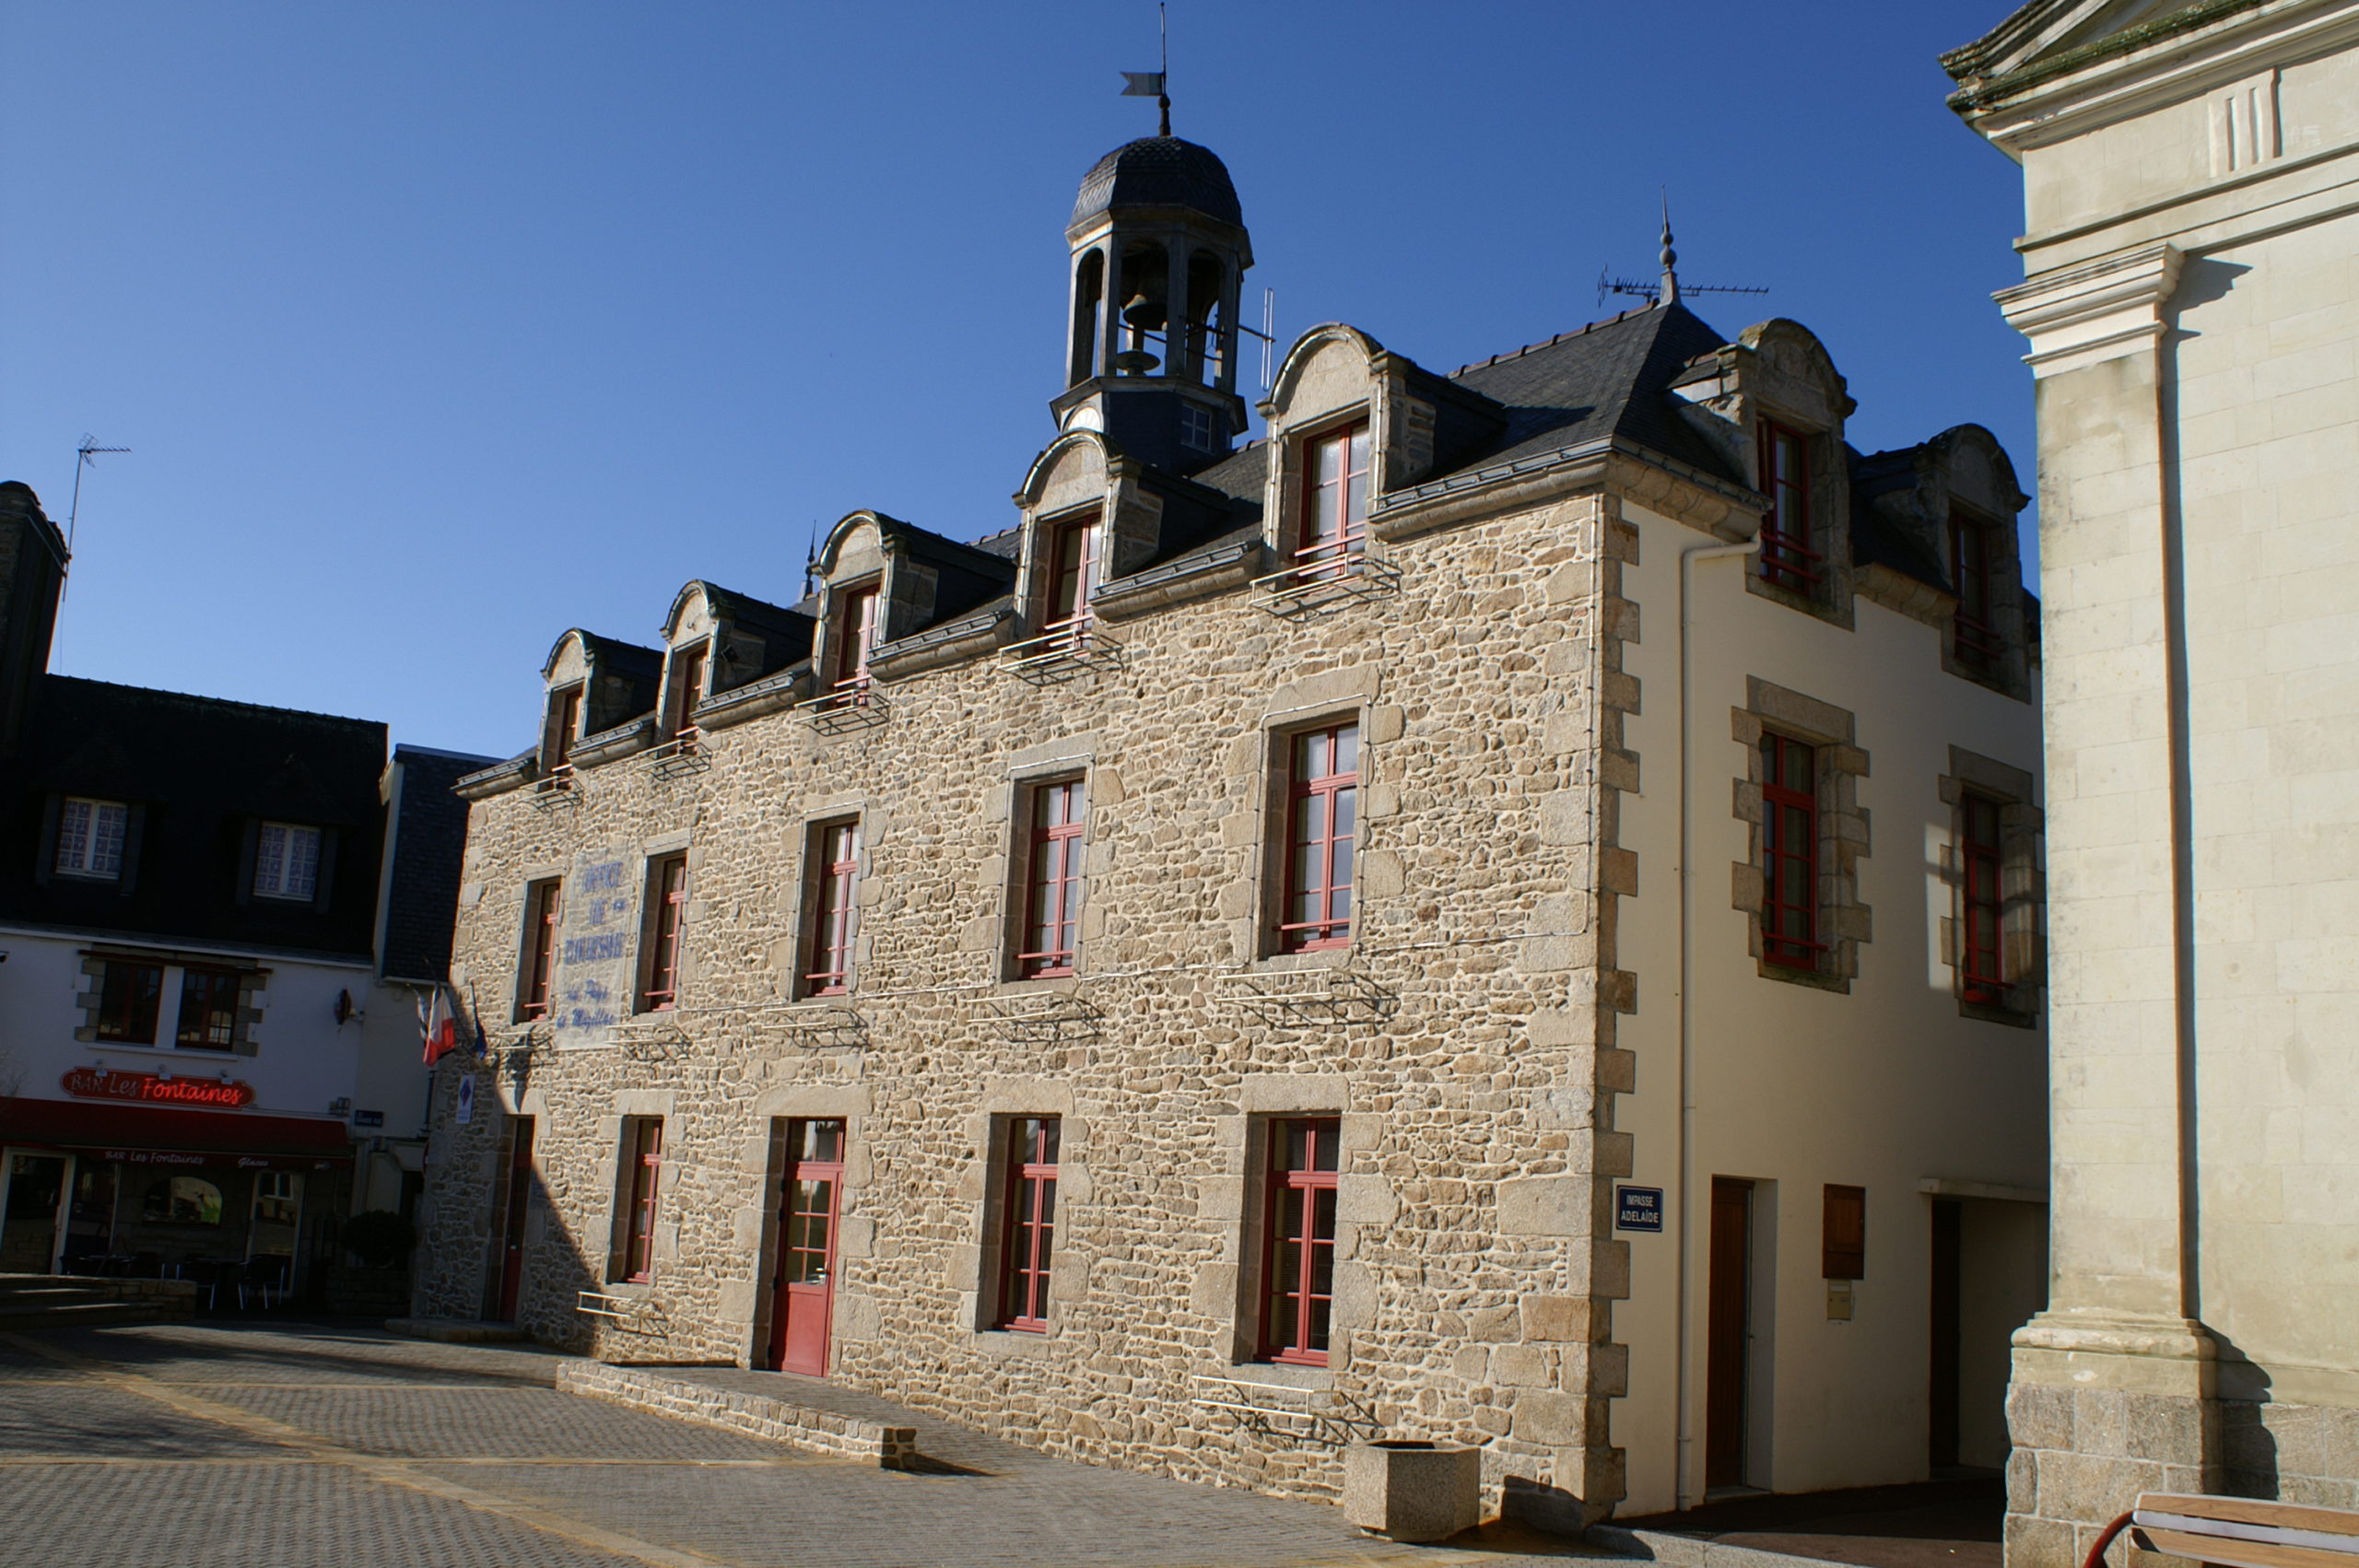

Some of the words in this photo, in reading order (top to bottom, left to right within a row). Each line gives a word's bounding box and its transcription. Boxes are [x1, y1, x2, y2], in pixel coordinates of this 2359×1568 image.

[70, 1073, 102, 1093] BAR
[109, 1071, 138, 1097] Les
[142, 1077, 242, 1105] Fontaines
[149, 1152, 205, 1165] Fontaines
[1626, 1194, 1653, 1207] IMPASSE
